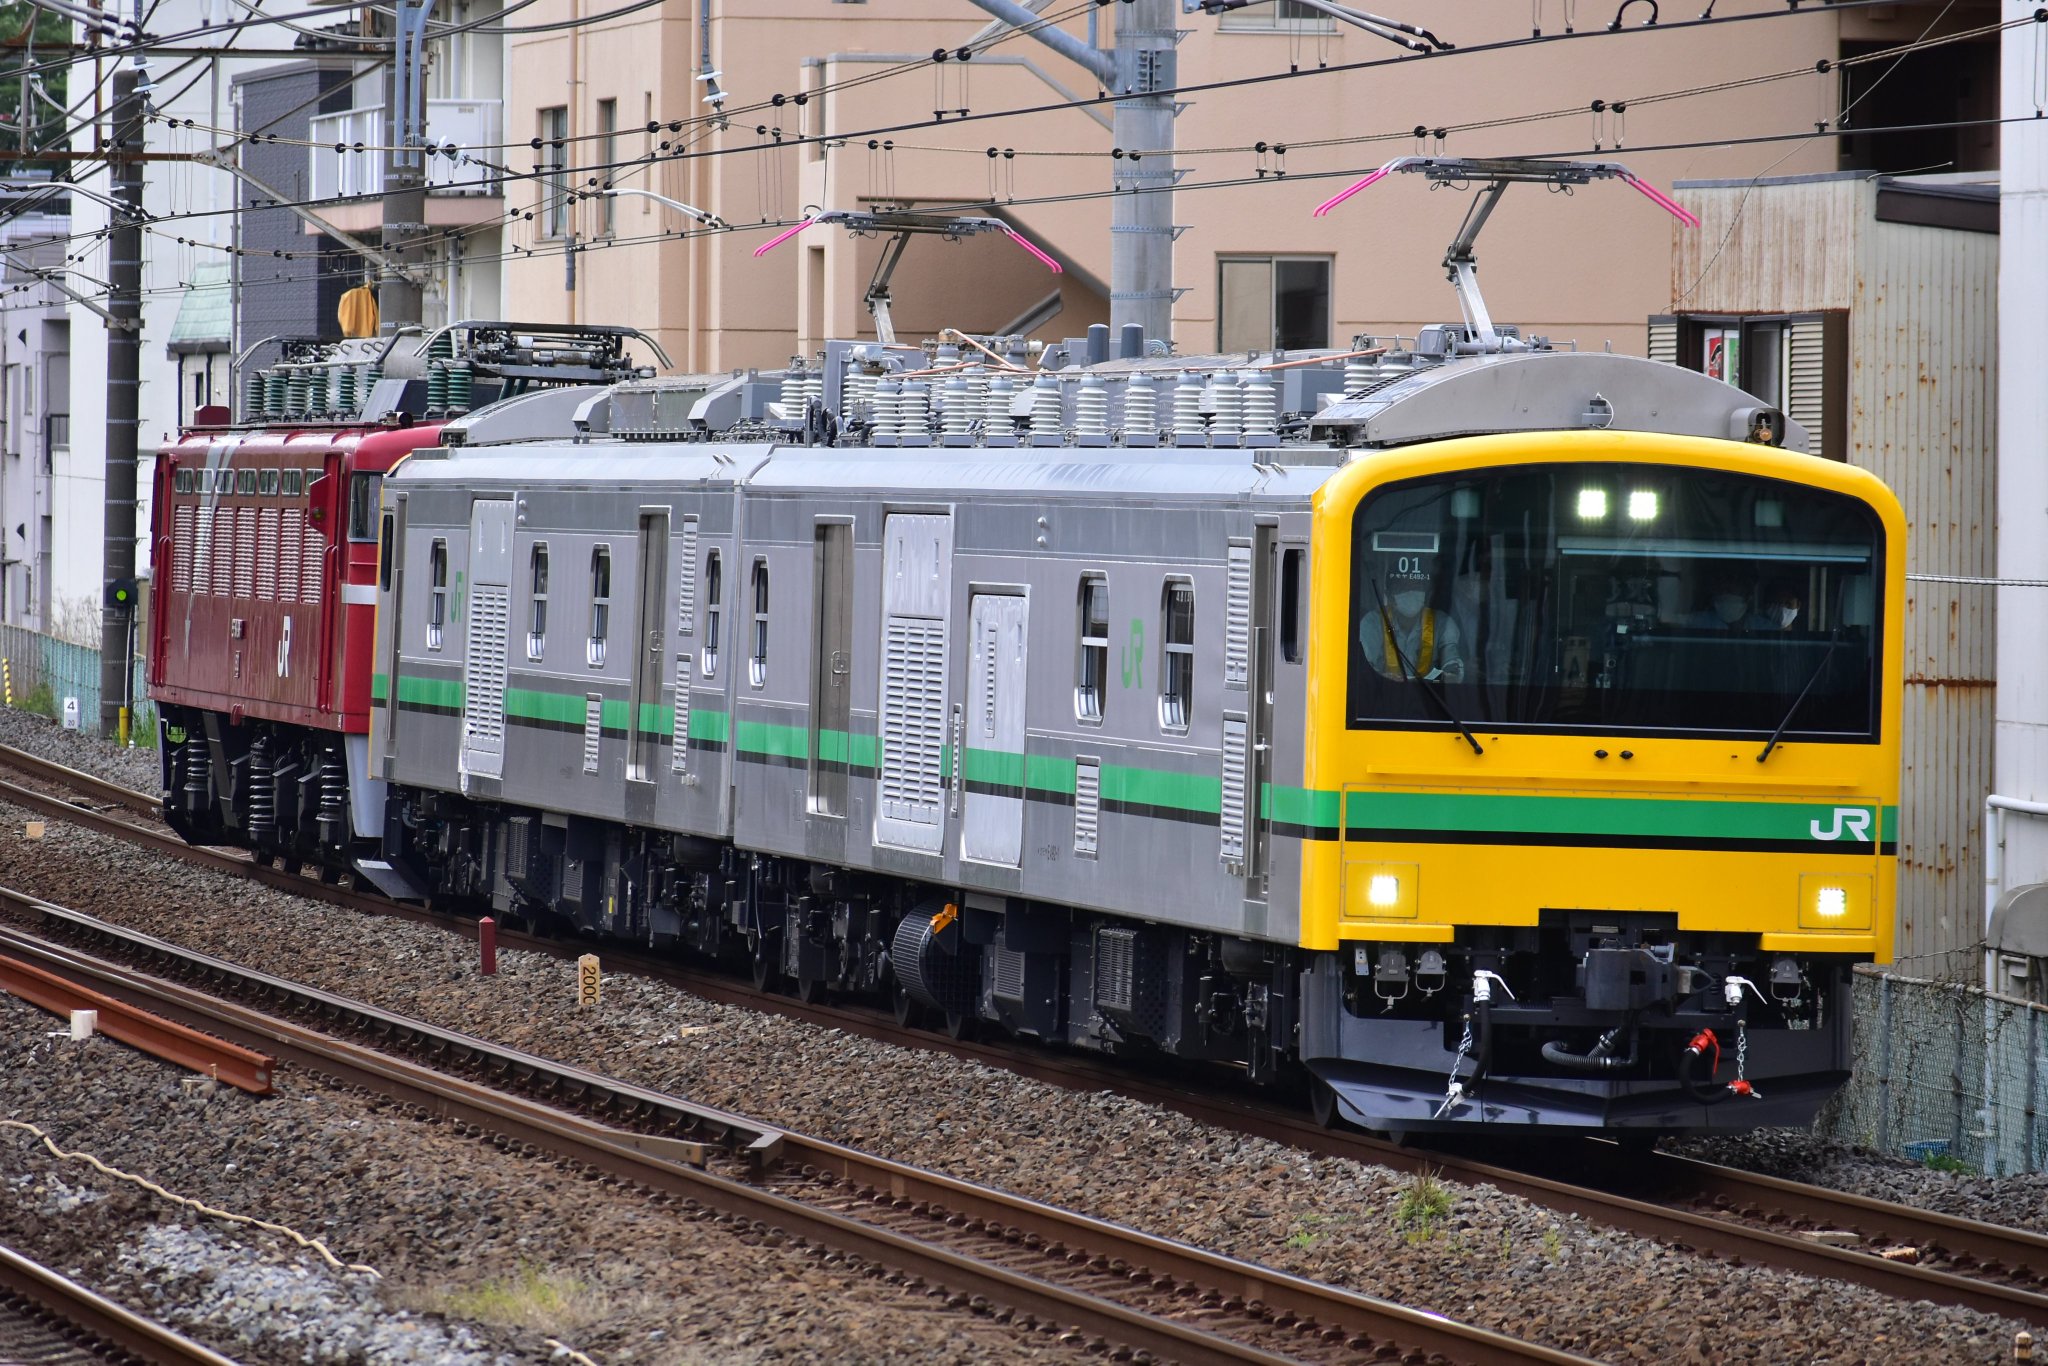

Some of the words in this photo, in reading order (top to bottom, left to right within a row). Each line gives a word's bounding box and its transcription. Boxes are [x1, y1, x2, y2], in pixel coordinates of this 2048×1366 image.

[1398, 556, 1421, 573] 01
[277, 615, 291, 678] JR
[1121, 618, 1144, 689] JR
[67, 701, 75, 711] 4
[1810, 807, 1871, 842] JR
